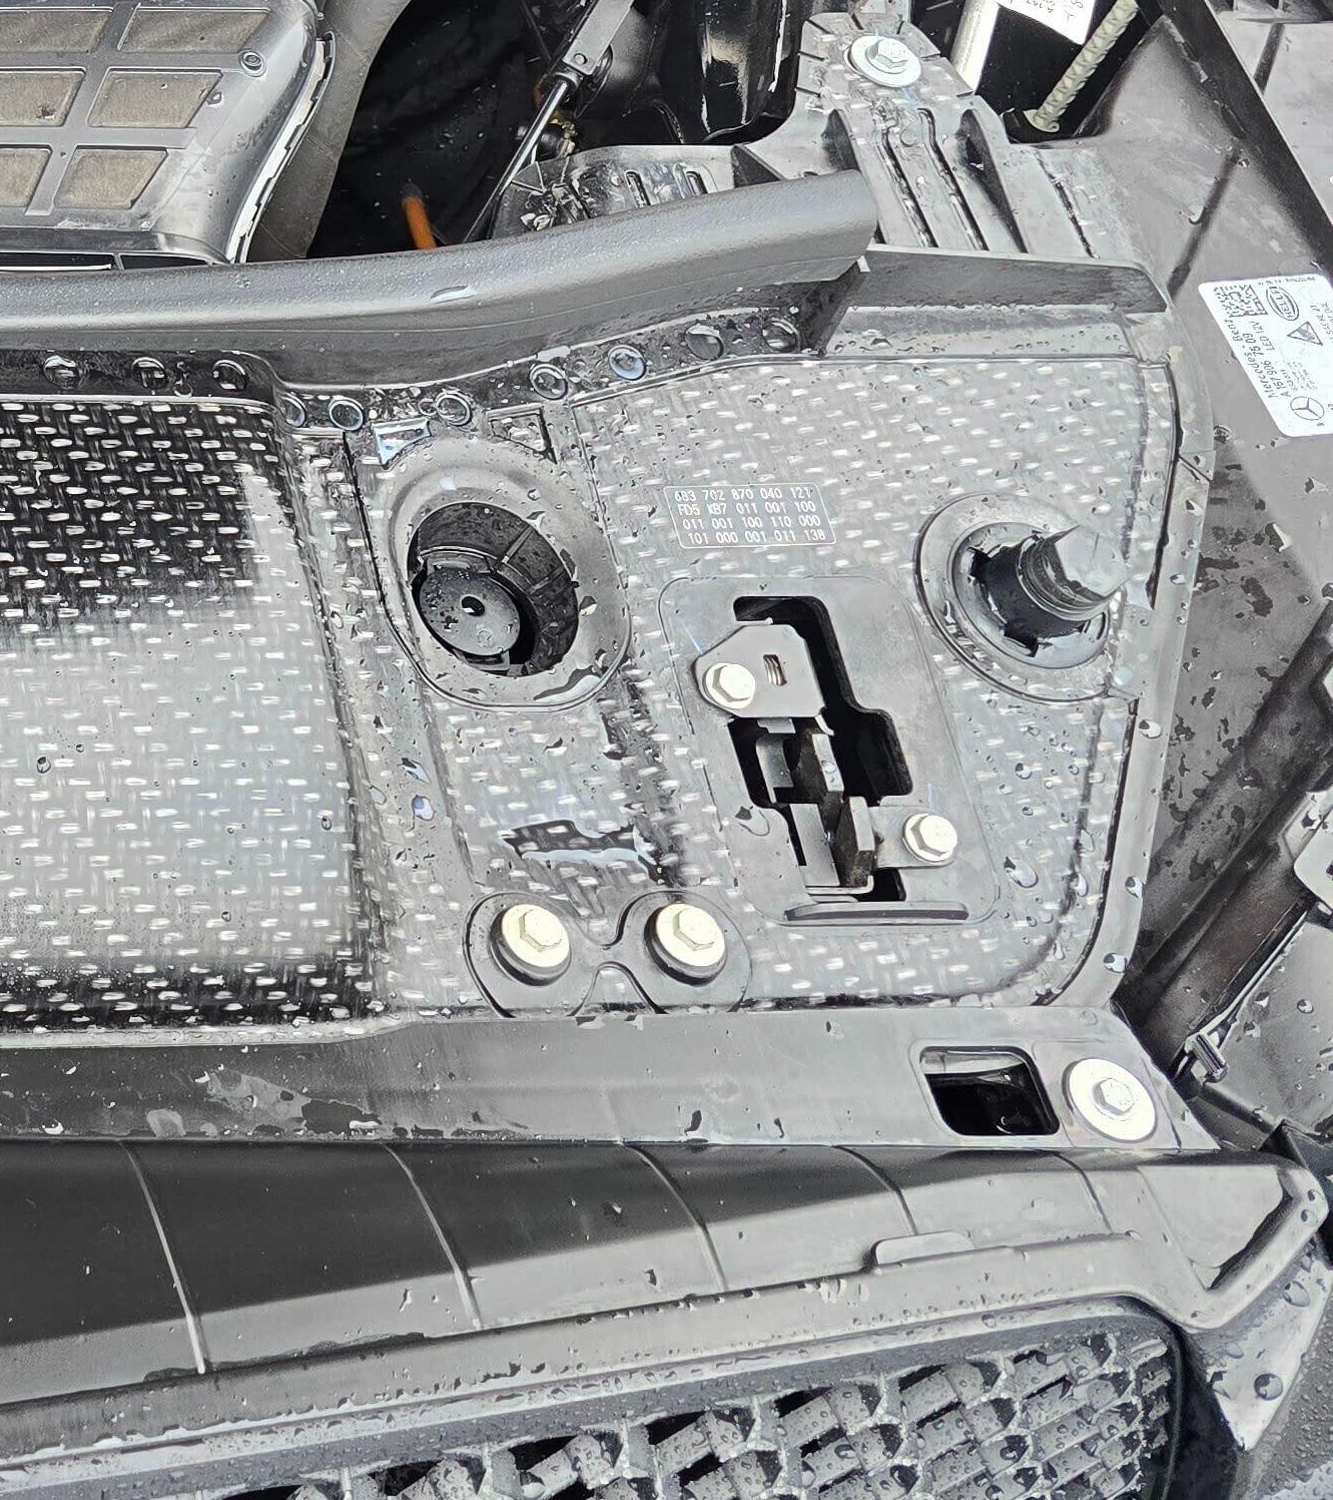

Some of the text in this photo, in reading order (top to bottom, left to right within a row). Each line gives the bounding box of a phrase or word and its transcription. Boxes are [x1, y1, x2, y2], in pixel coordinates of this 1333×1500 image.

[1259, 335, 1275, 351] LED
[702, 489, 726, 501] 702
[731, 488, 754, 500] 870
[760, 487, 783, 499] 040
[790, 486, 812, 498] 121
[736, 503, 758, 514] 011
[765, 502, 786, 514] 001
[796, 501, 817, 513] 100
[683, 515, 821, 530] 011 001 100 110 000
[688, 529, 826, 544] 101 000 001 011 138
